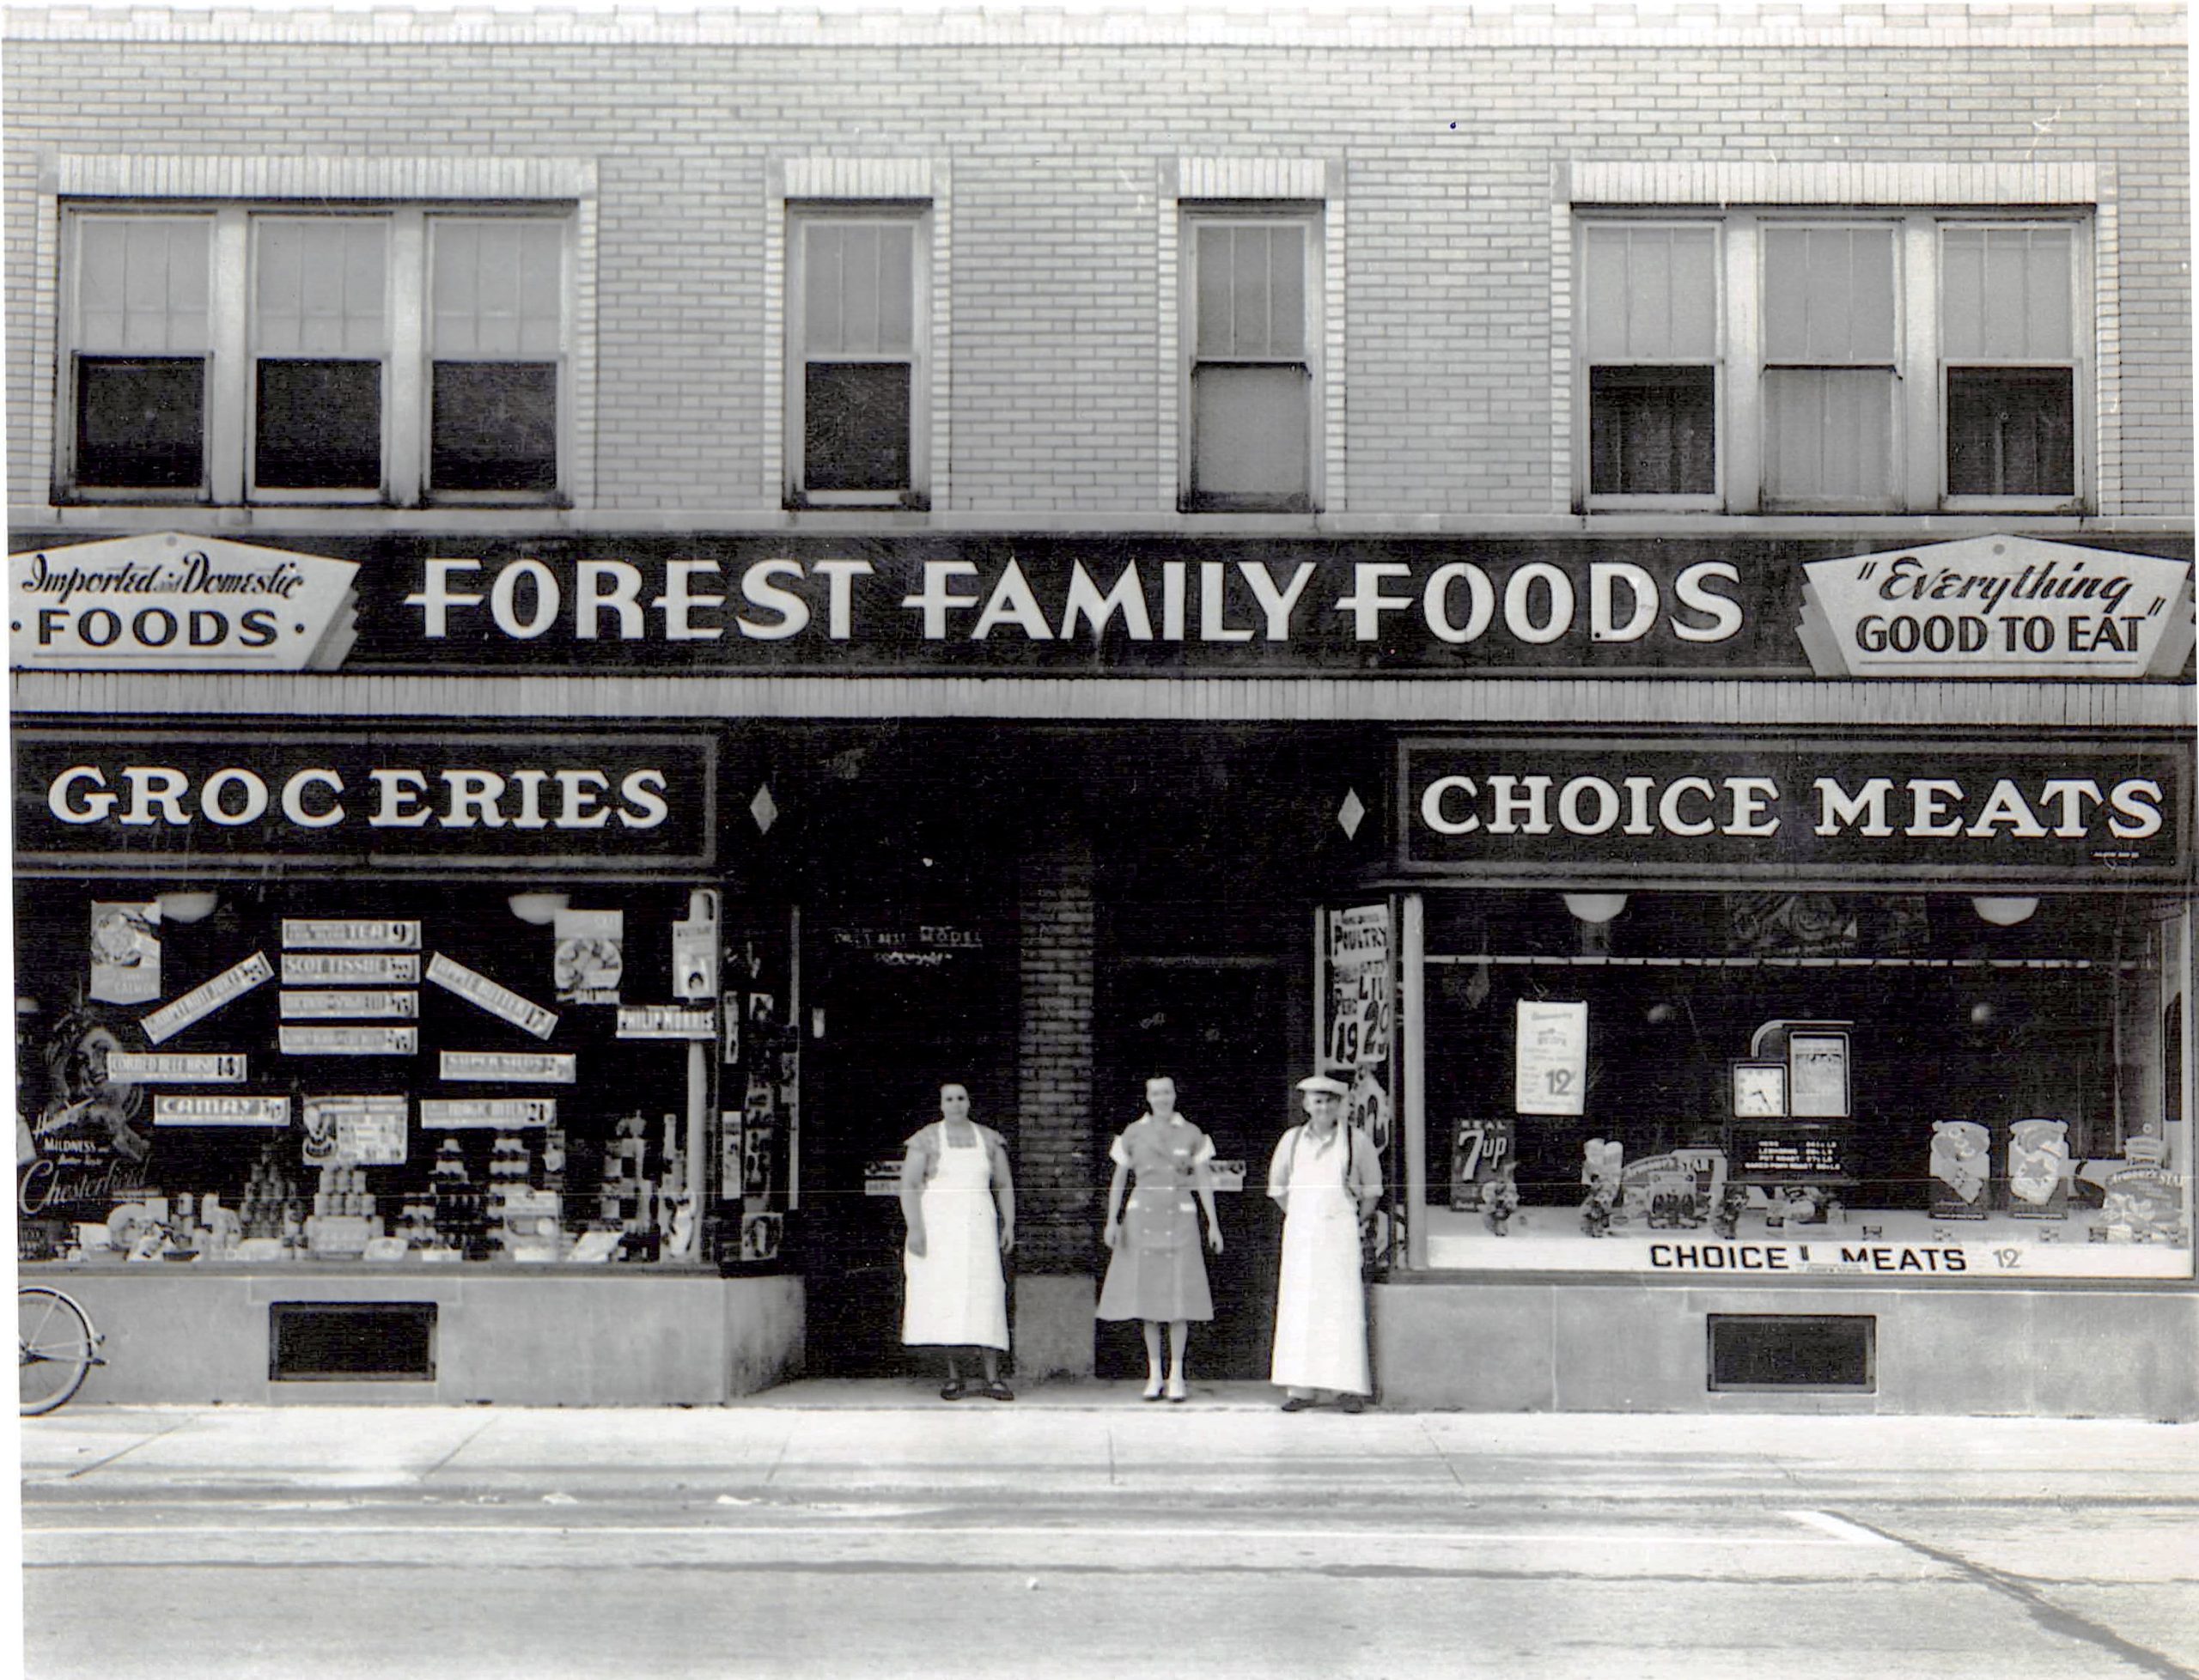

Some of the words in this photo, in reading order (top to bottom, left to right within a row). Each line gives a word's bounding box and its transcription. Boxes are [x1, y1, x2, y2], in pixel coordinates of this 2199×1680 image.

[22, 553, 162, 603] Imported
[182, 551, 304, 600] Domestic
[405, 559, 873, 640] FOREST
[902, 557, 1316, 641] FAMILY
[1336, 563, 1742, 642] FOODS
[39, 607, 278, 647] FOODS
[1856, 615, 1989, 653] GOOD
[1999, 615, 2056, 653] TO
[49, 767, 667, 827] GROCERIES
[1422, 776, 1780, 835] CHOICE
[1814, 778, 2163, 837] MEATS
[19, 1153, 152, 1215] Chesterfield
[1651, 1245, 1788, 1269] CHOICE
[1842, 1248, 1966, 1271] MEATS
